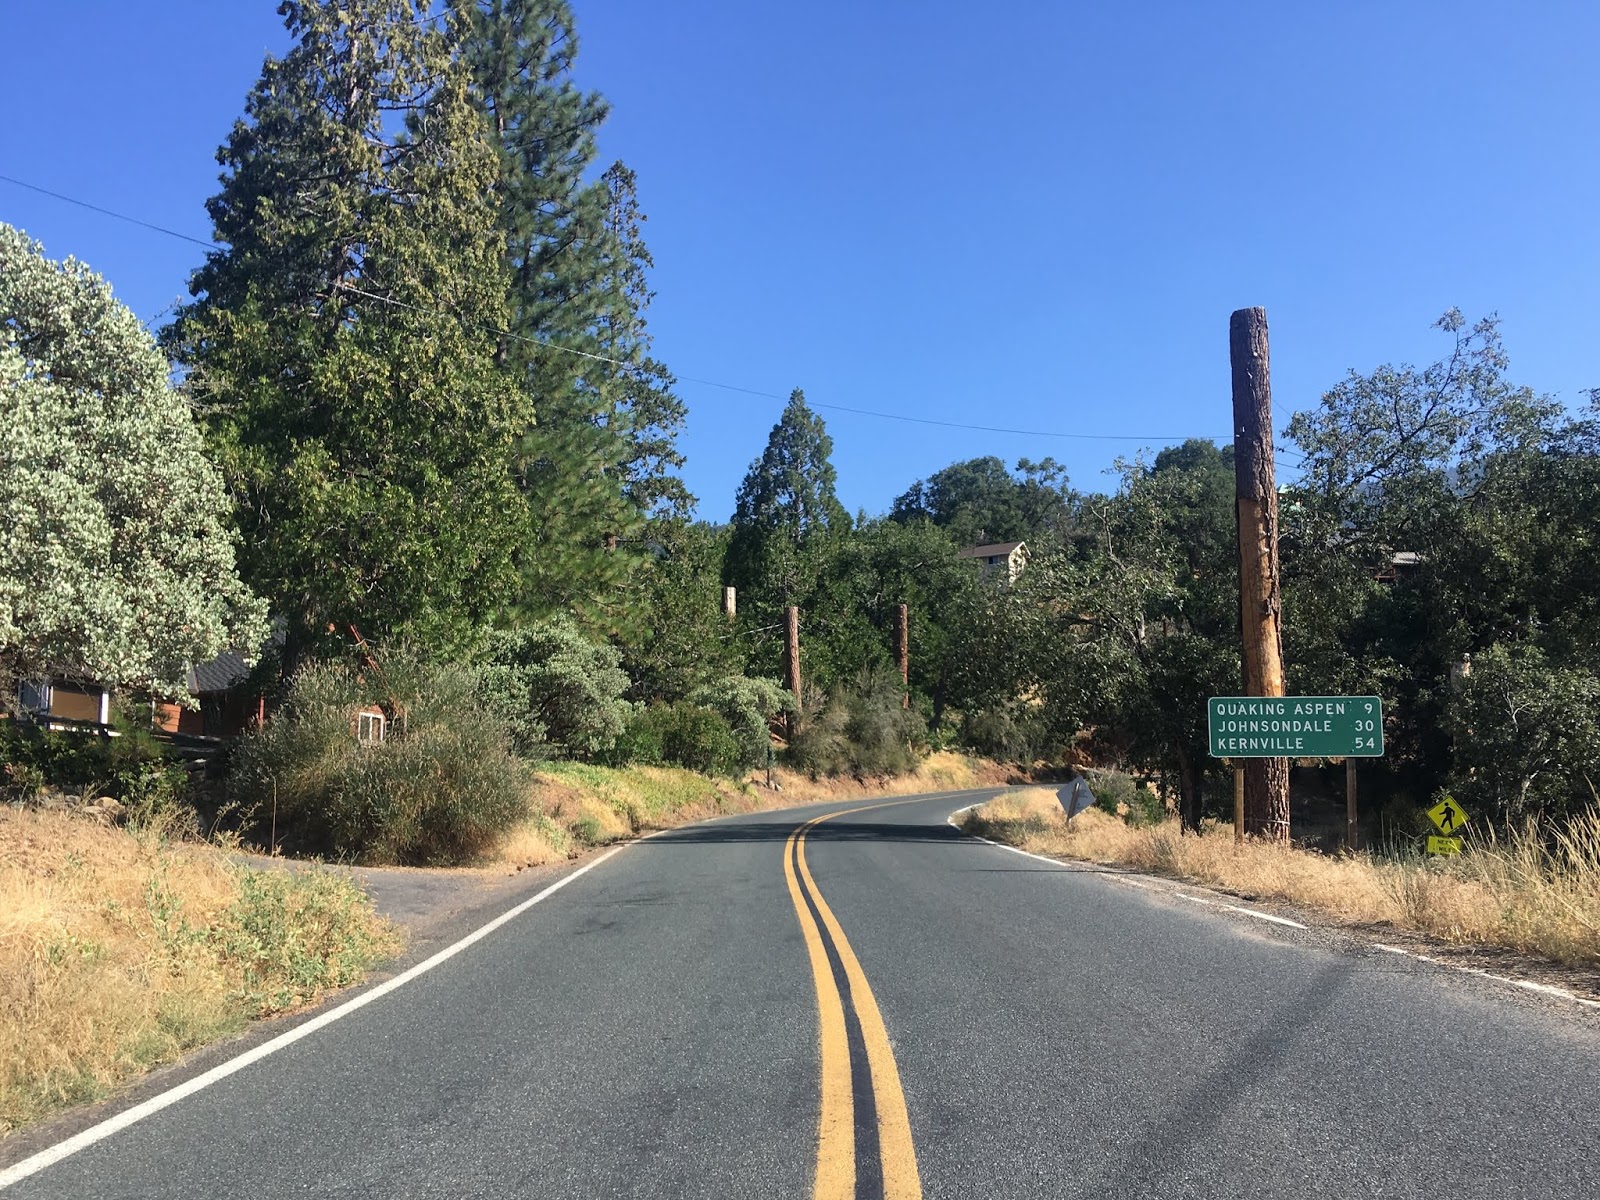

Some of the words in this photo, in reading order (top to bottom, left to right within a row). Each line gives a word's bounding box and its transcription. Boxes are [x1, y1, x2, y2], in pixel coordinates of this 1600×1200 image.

[1217, 703, 1285, 715] QUAKING
[1294, 703, 1345, 715] ASPEN
[1364, 703, 1373, 714] 9
[1218, 720, 1332, 732] JOHNSONDALE
[1355, 720, 1374, 732] 30
[1218, 738, 1304, 750] KERNVILLE
[1355, 737, 1375, 749] 54
